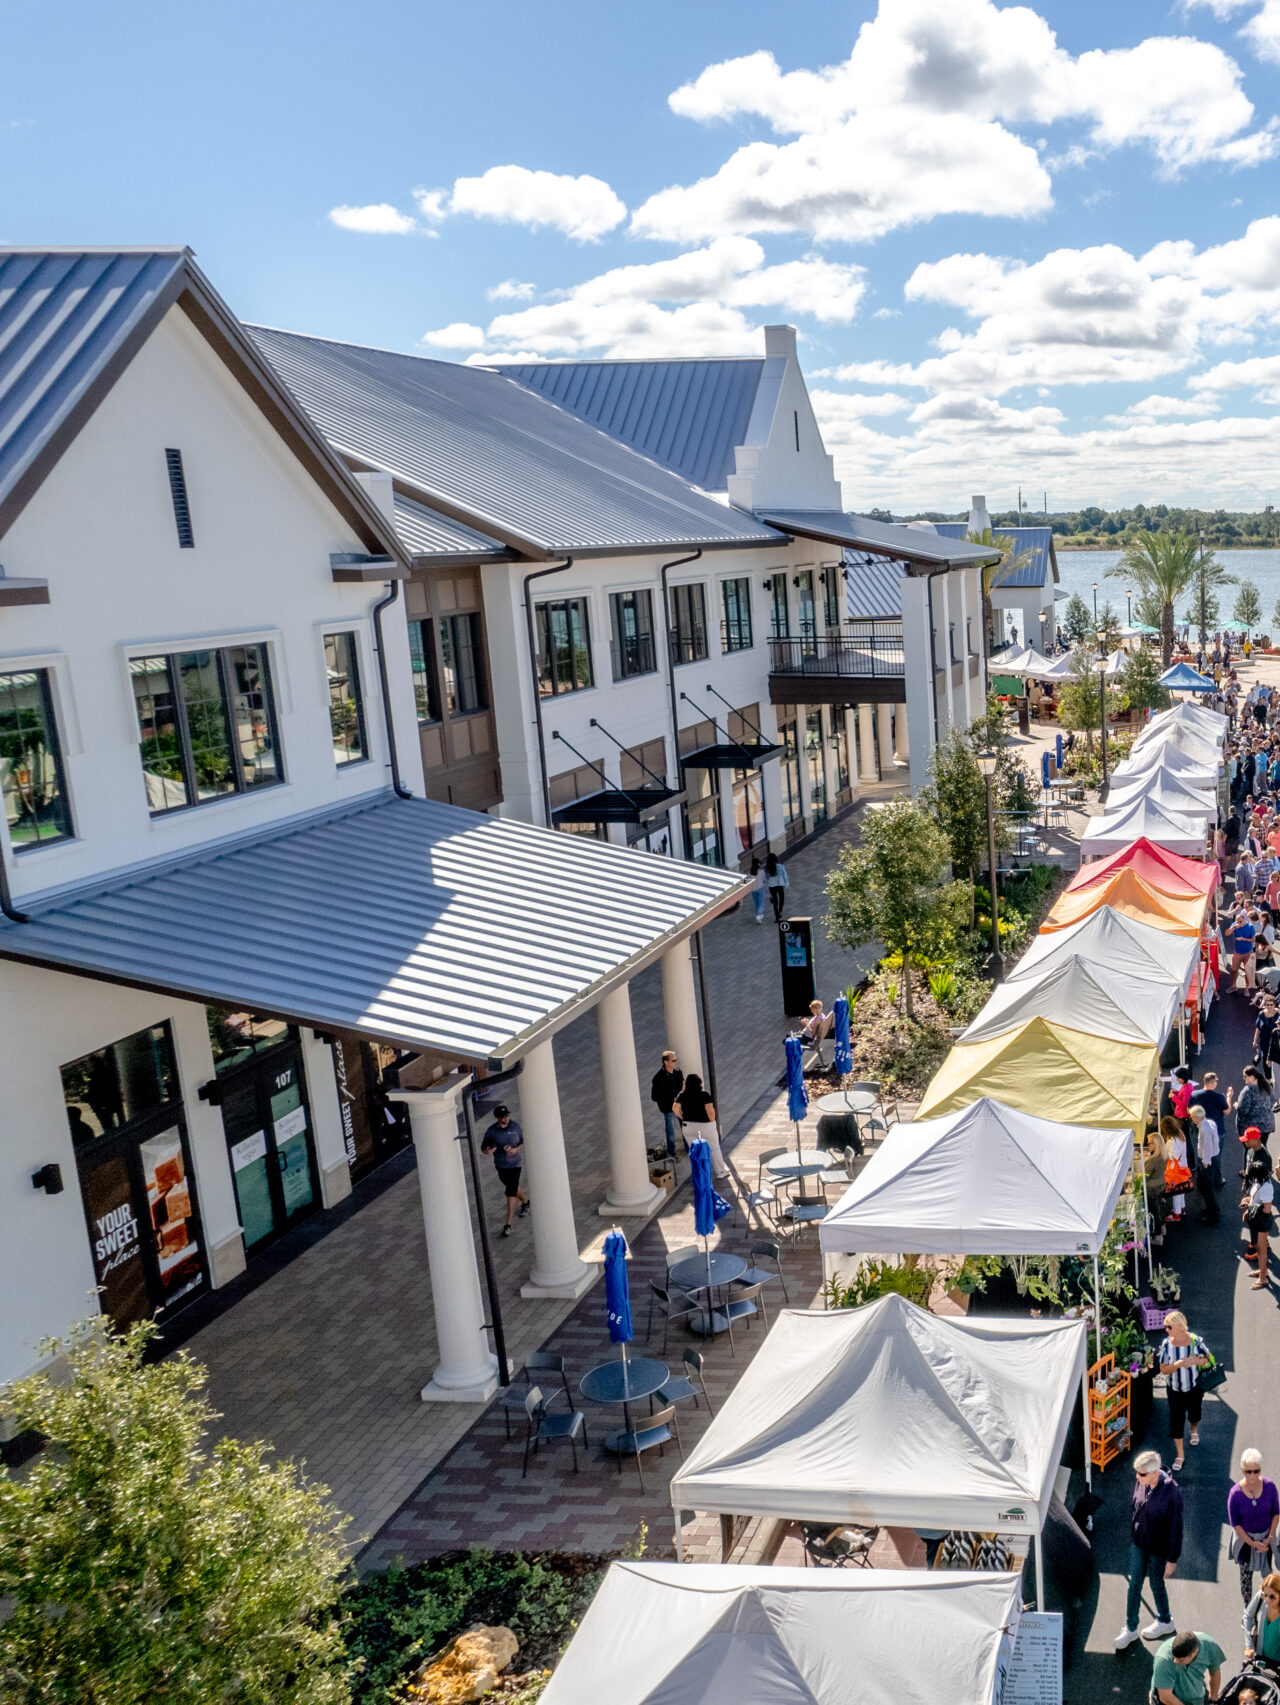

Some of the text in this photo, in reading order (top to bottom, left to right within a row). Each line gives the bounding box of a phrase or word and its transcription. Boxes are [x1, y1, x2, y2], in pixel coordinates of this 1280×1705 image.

[275, 1070, 291, 1089] 107
[335, 1040, 357, 1165] YOUR SWEET place
[96, 1203, 131, 1237] YOUR
[95, 1218, 138, 1261] SWEET
[101, 1244, 141, 1281] place
